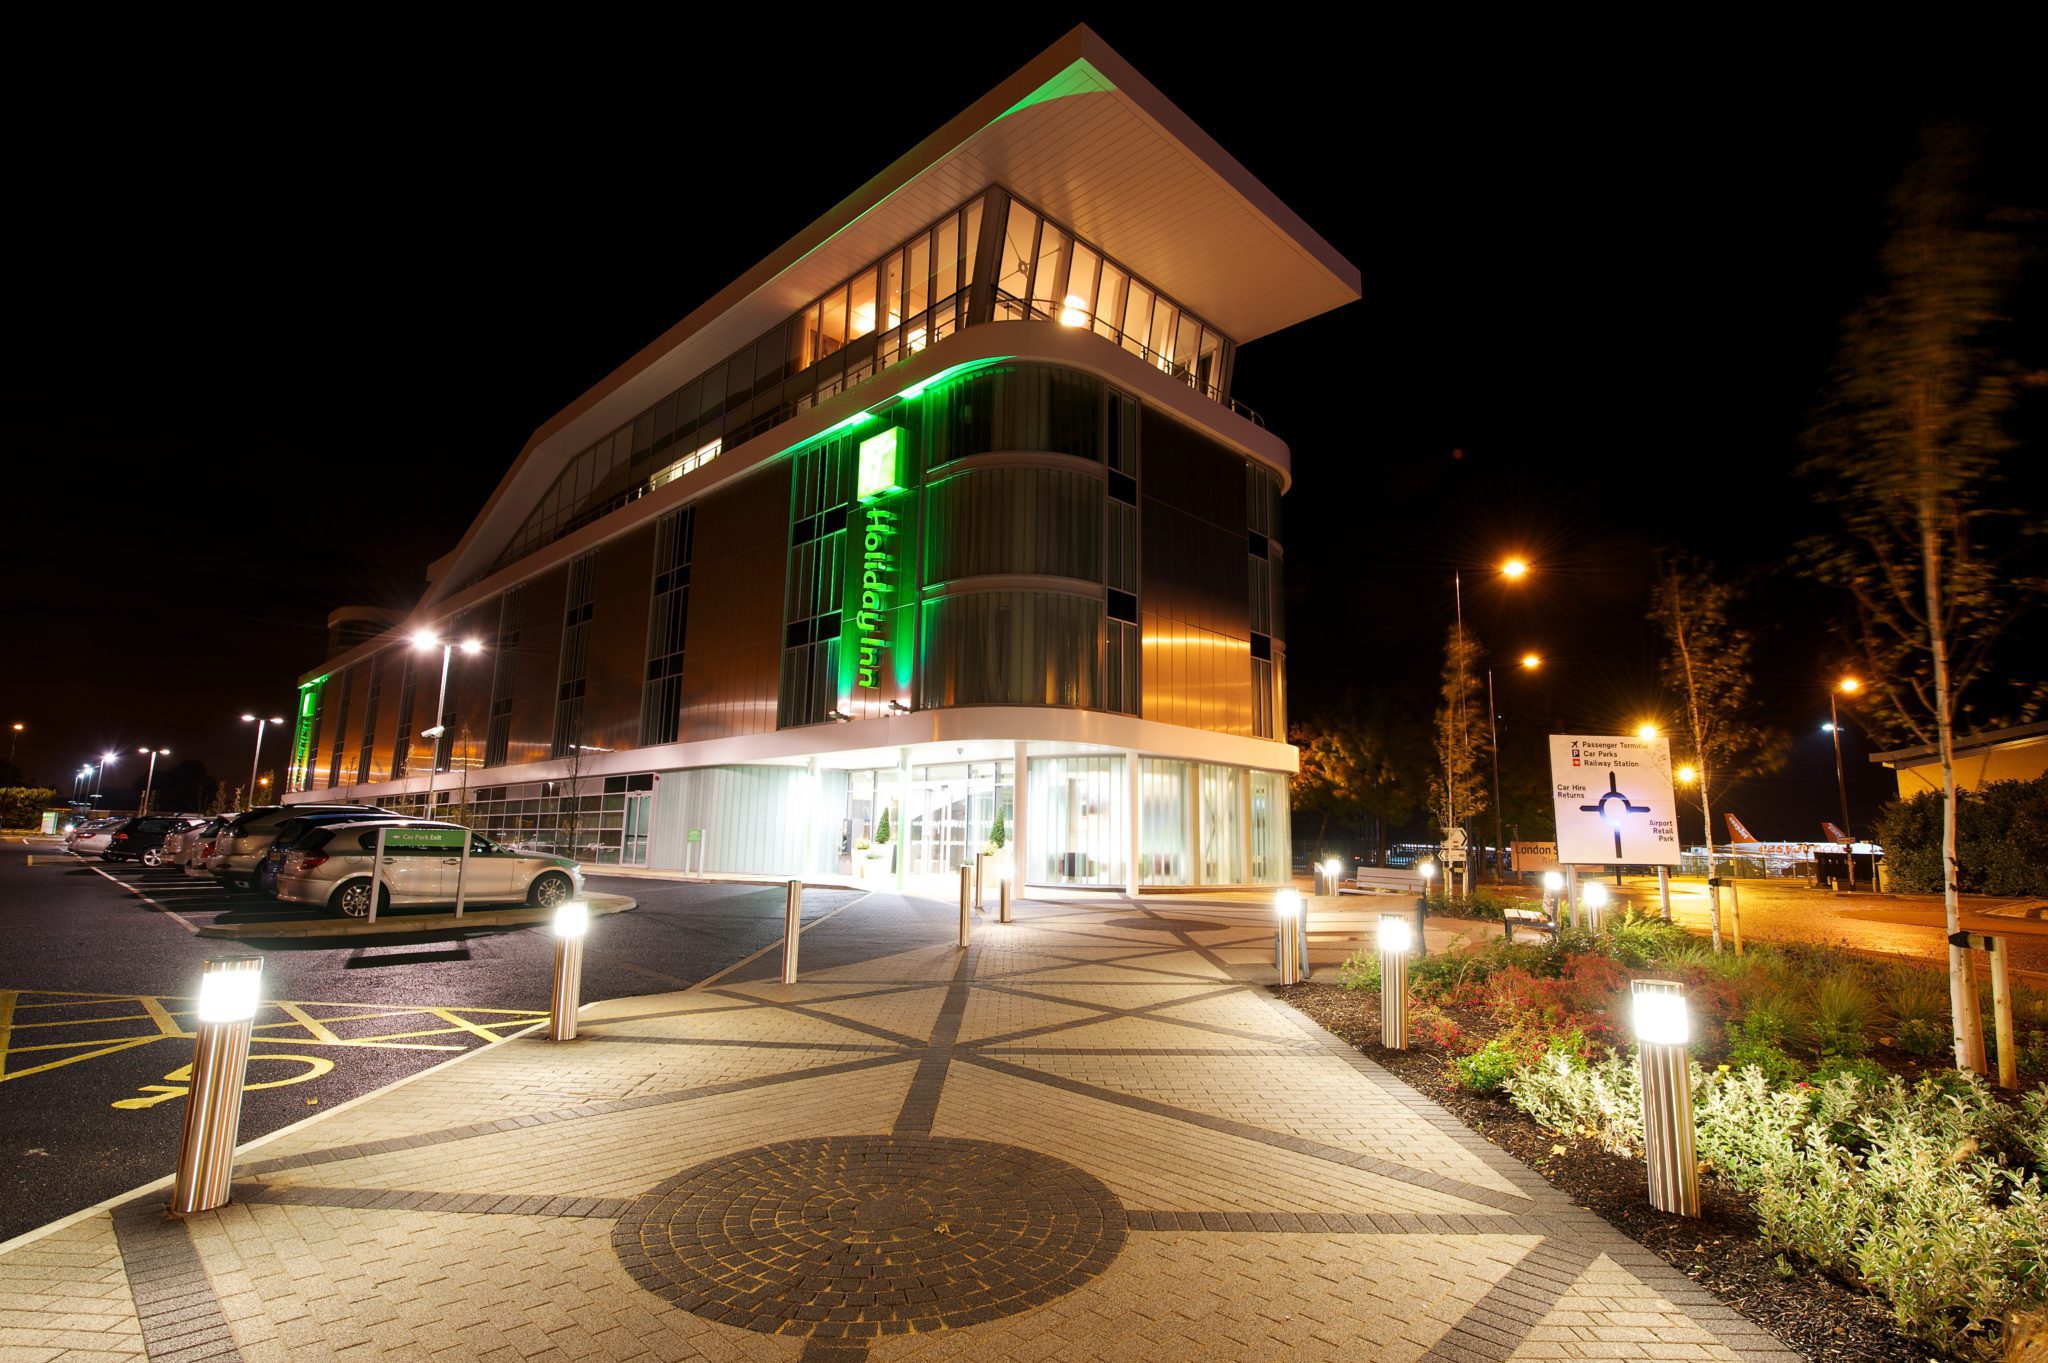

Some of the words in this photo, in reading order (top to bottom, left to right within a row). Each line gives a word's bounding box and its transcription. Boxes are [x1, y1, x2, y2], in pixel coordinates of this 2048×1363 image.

[857, 508, 891, 631] Holiday
[859, 637, 885, 687] Inn
[1582, 741, 1617, 749] Passenger
[1620, 742, 1649, 750] Terminal
[1598, 750, 1618, 758] Parks
[1584, 760, 1611, 768] Railway
